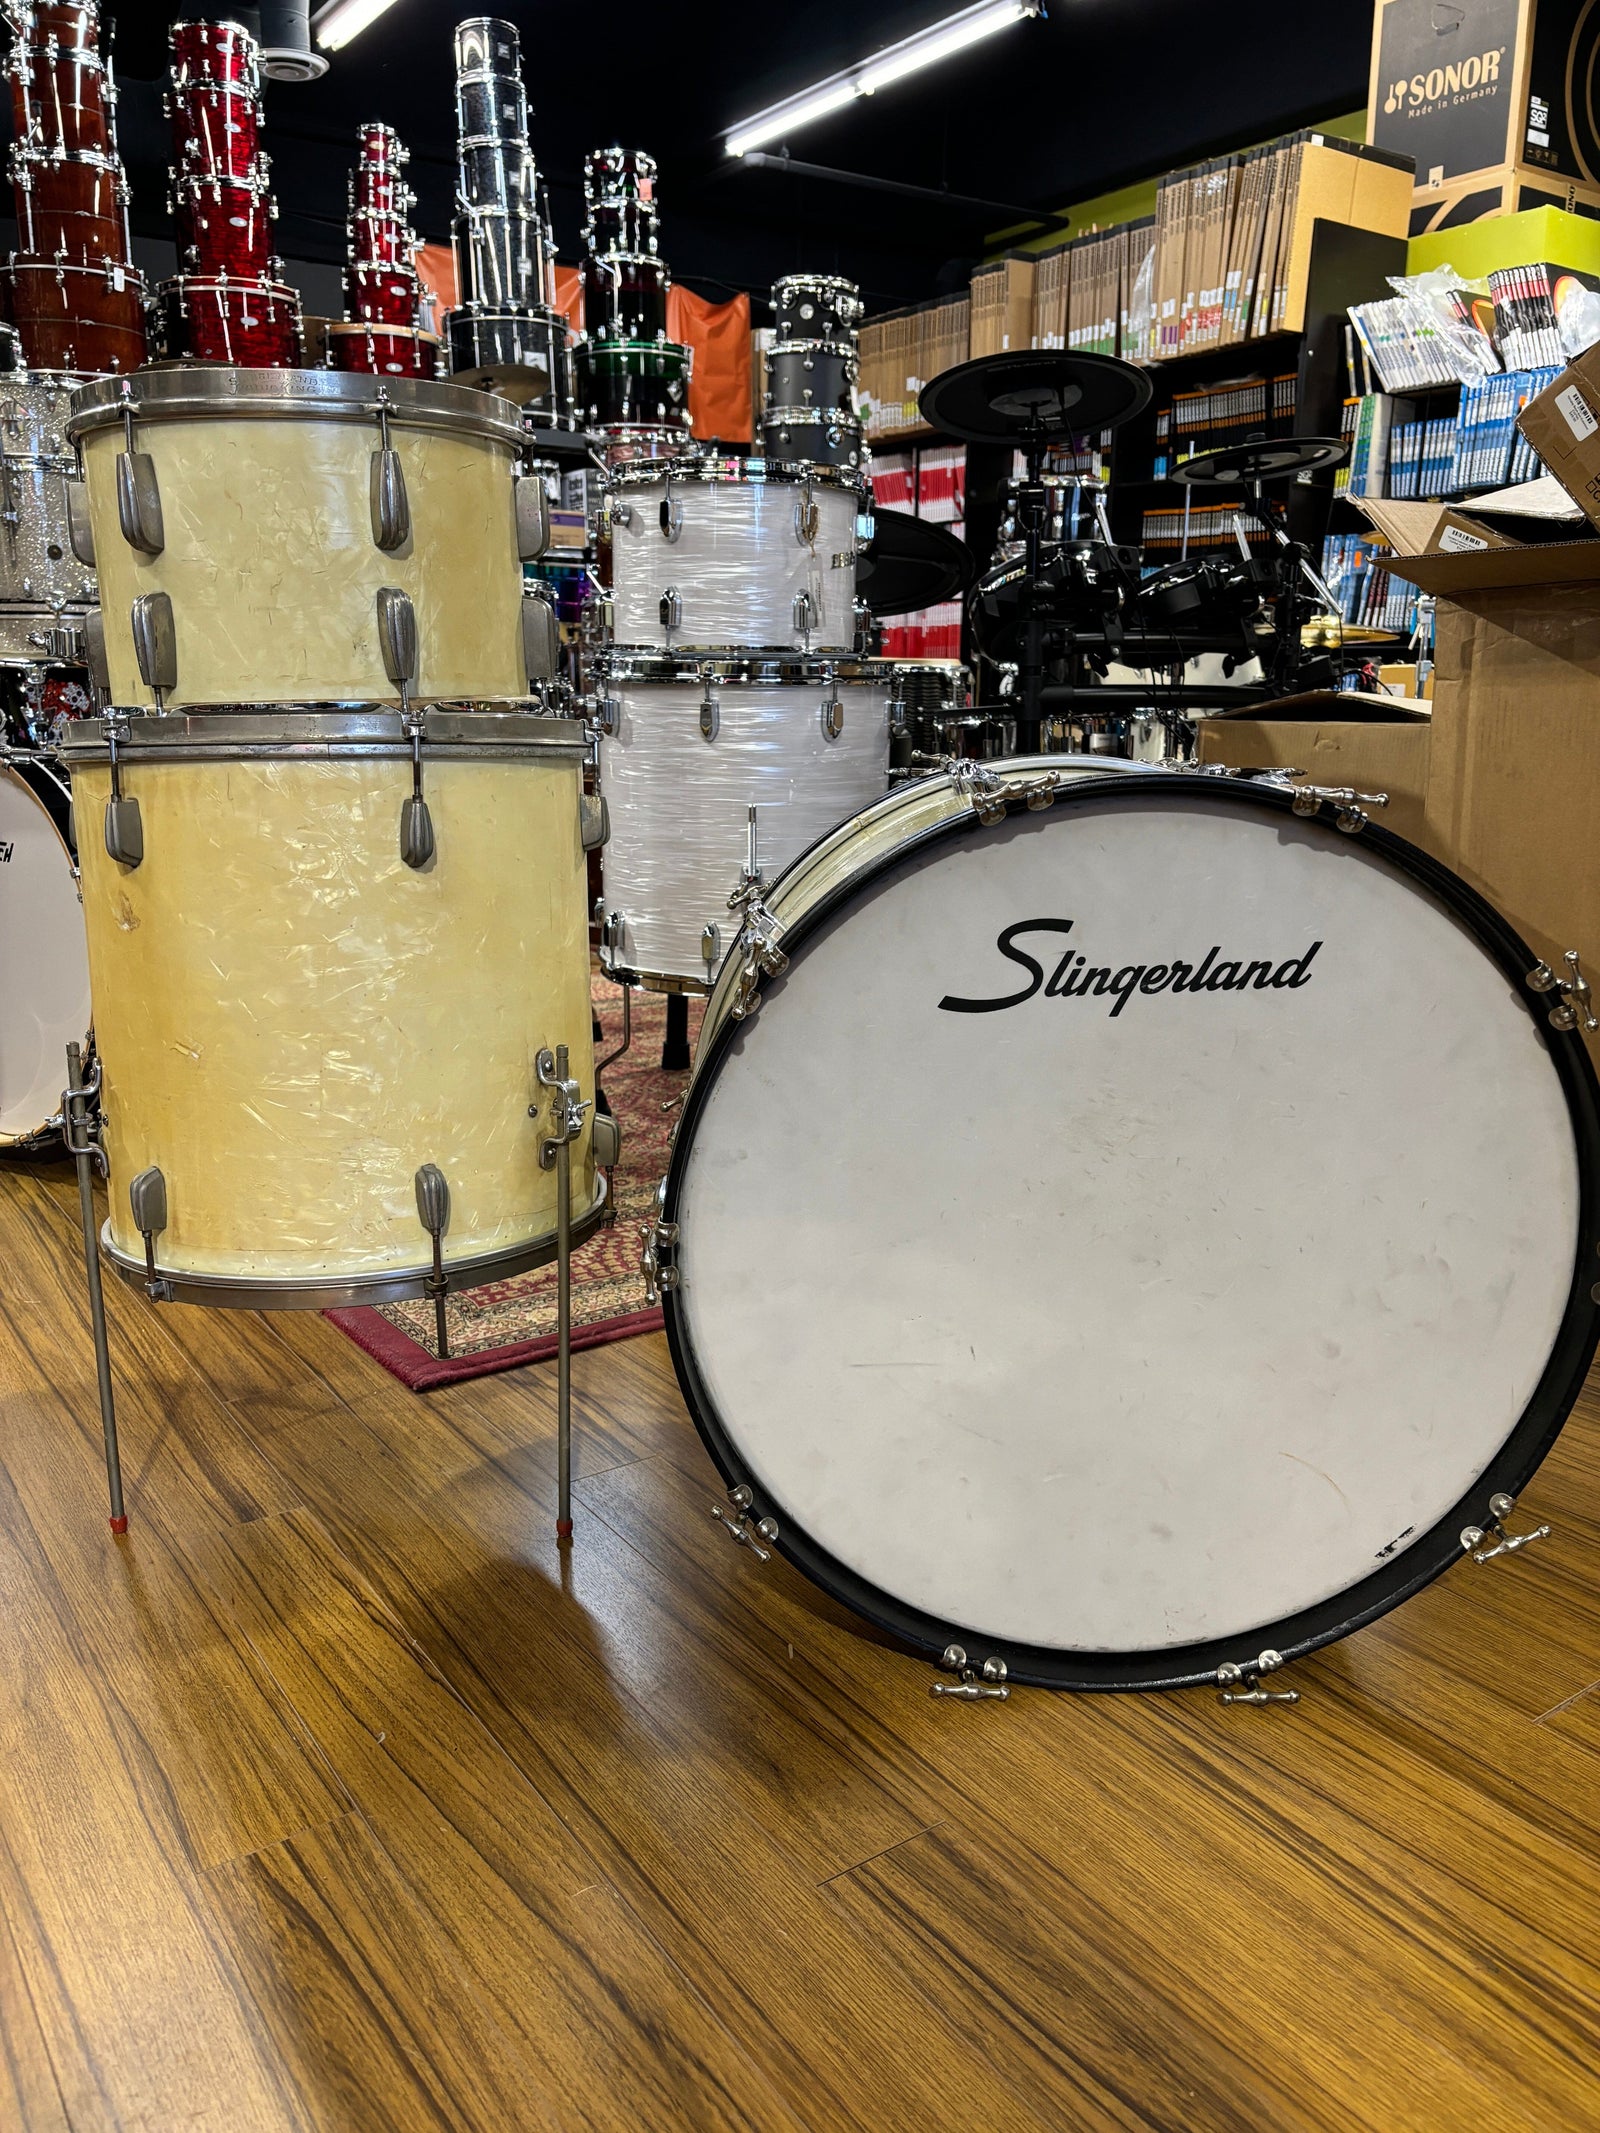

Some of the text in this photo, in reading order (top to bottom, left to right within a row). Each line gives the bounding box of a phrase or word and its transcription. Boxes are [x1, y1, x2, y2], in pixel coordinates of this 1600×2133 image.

[1408, 49, 1500, 106] SONOR
[1408, 85, 1498, 119] Made in Germany
[937, 918, 1324, 1017] Slingerland
